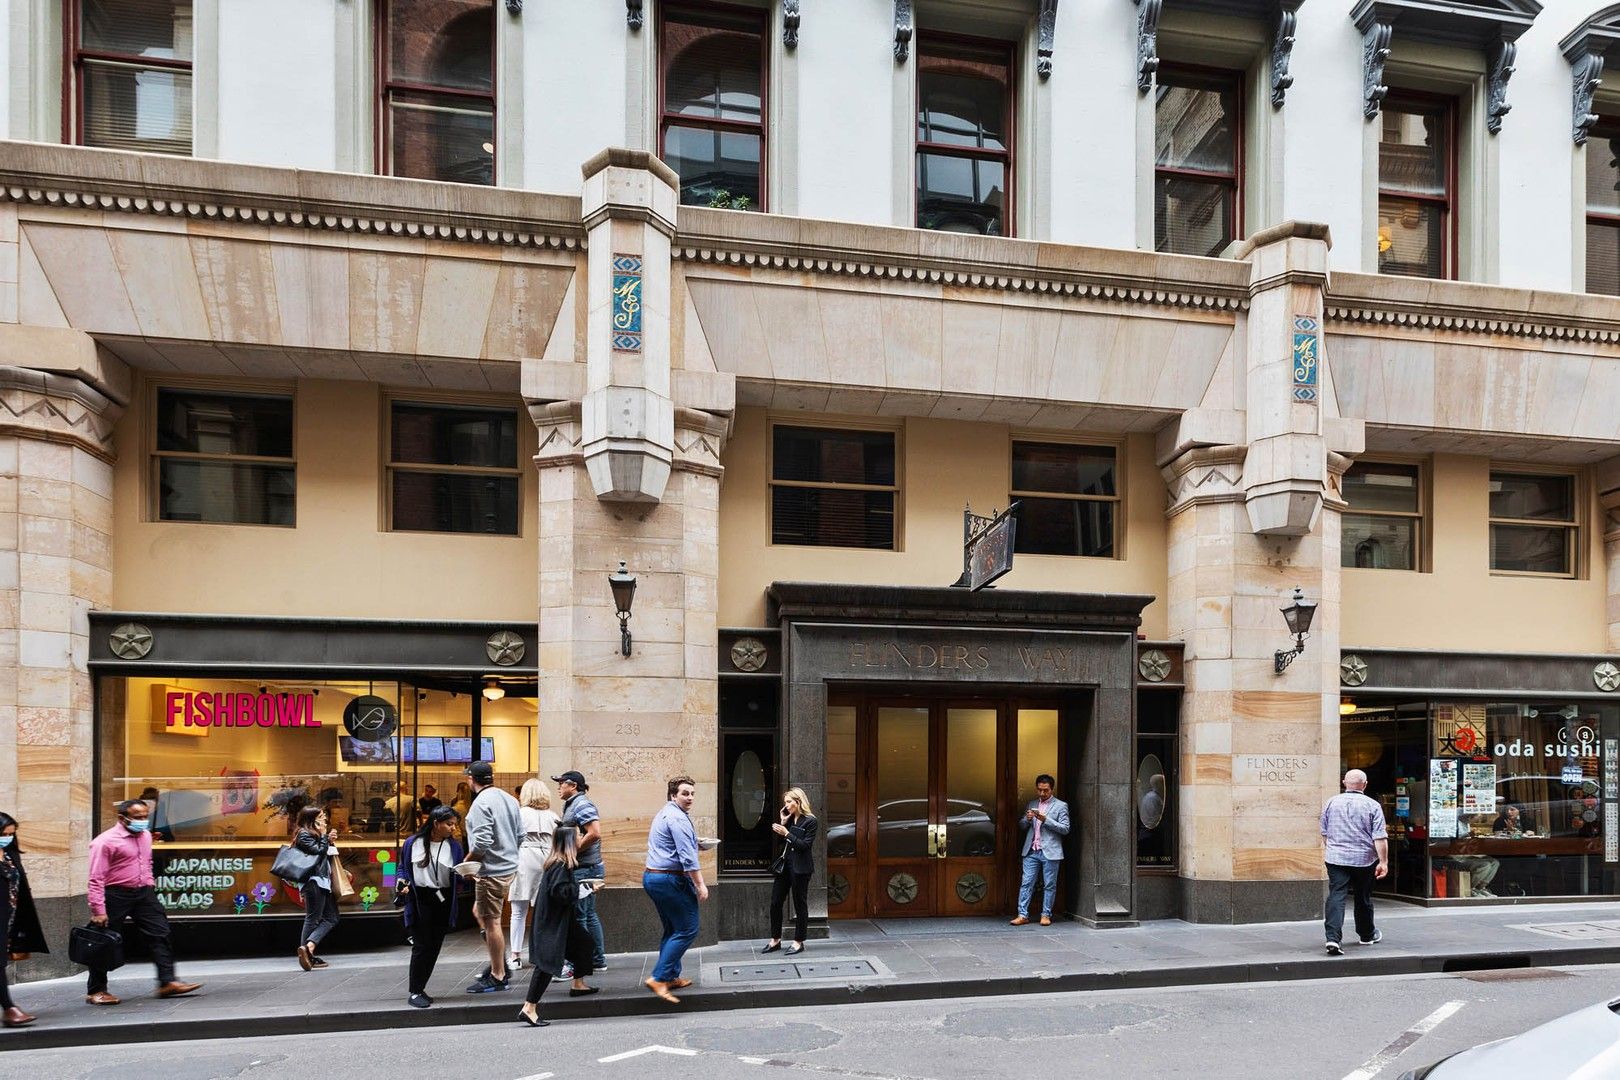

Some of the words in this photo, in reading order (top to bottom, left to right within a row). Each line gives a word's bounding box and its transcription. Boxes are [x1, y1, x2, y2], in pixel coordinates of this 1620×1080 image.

[851, 643, 989, 670] FLINDERS
[1018, 647, 1073, 671] WAY
[166, 692, 322, 727] FISHBOWL
[1494, 739, 1535, 757] oda
[1545, 740, 1600, 757] sushi
[1247, 758, 1309, 769] FLINDERS
[1260, 771, 1296, 781] HOUSE
[166, 858, 254, 872] JAPANESE
[155, 875, 235, 891] INSPIRED
[157, 893, 214, 908] ALADS
